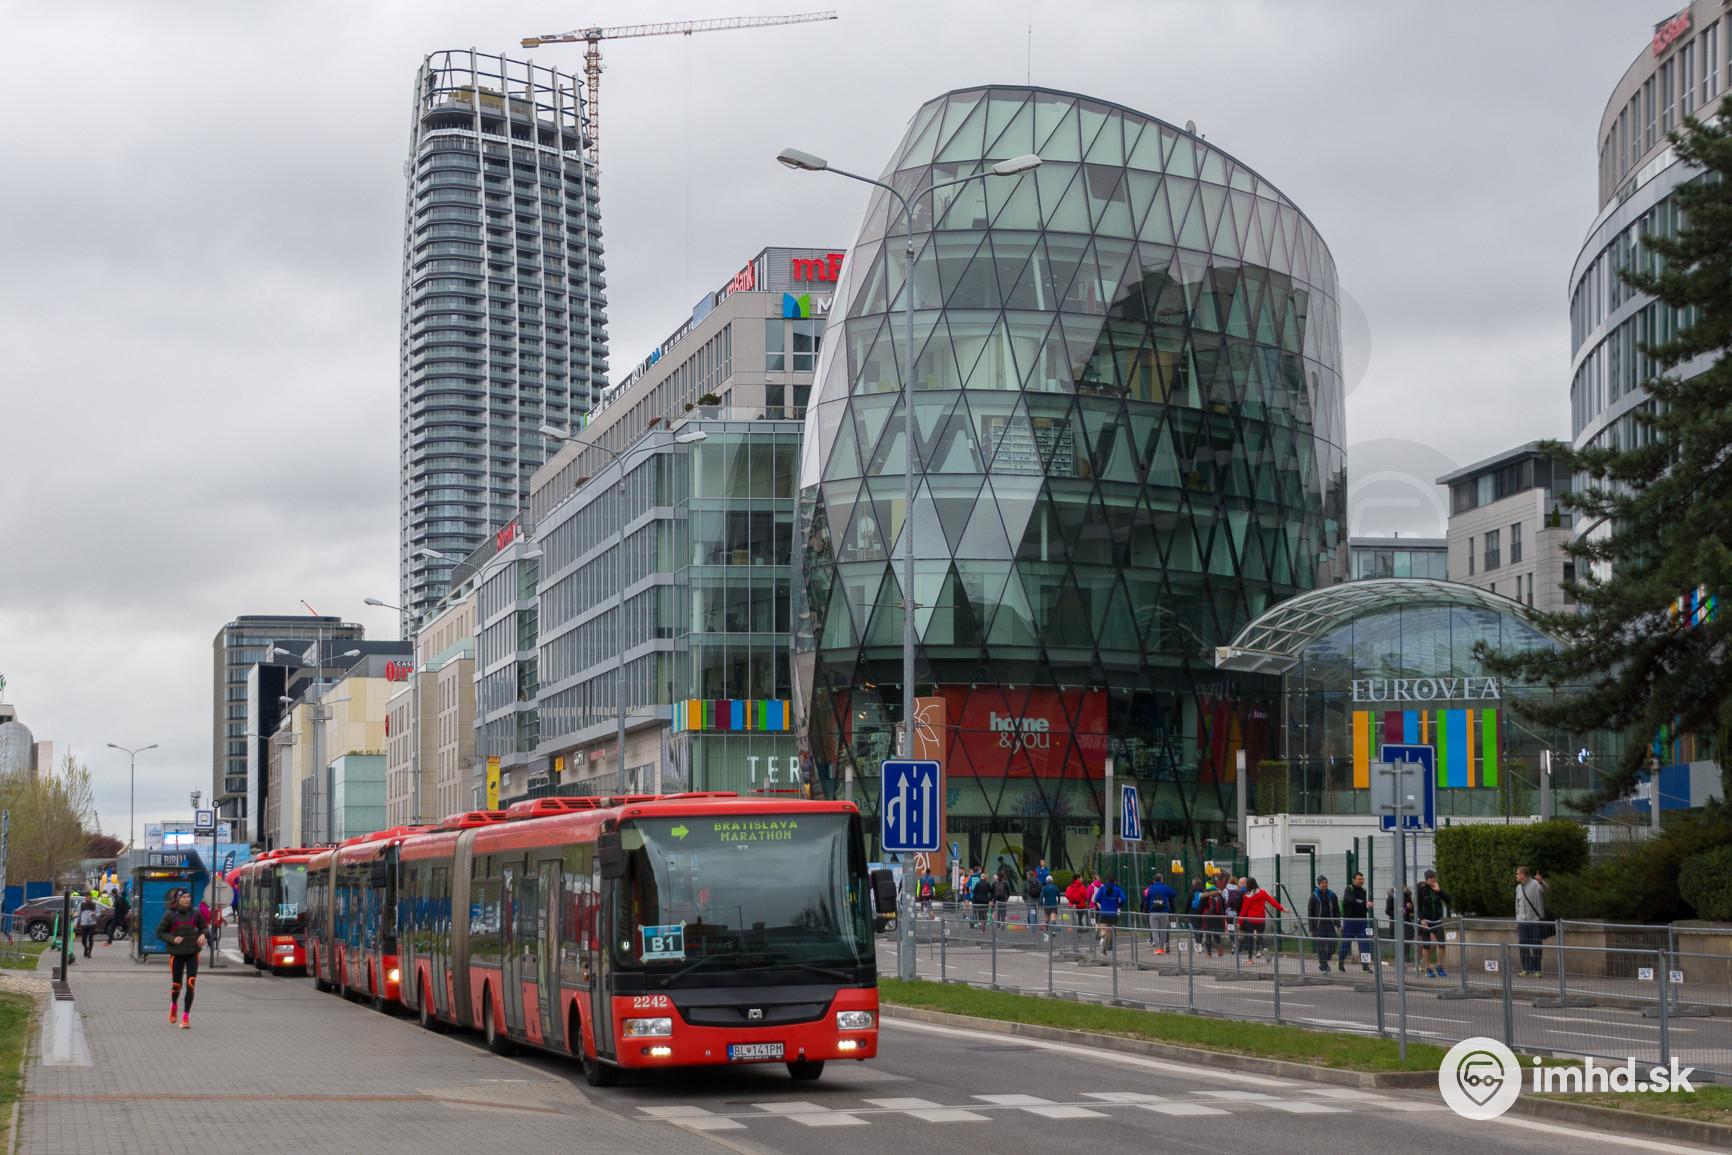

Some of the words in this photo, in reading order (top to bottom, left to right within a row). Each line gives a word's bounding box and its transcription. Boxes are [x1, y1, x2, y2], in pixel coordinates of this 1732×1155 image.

[1352, 677, 1500, 702] EUROVEA
[990, 712, 1050, 732] home
[714, 820, 798, 831] BRATISLAVA
[720, 830, 792, 842] MARATHON
[652, 936, 674, 951] B1
[633, 996, 668, 1008] 2242
